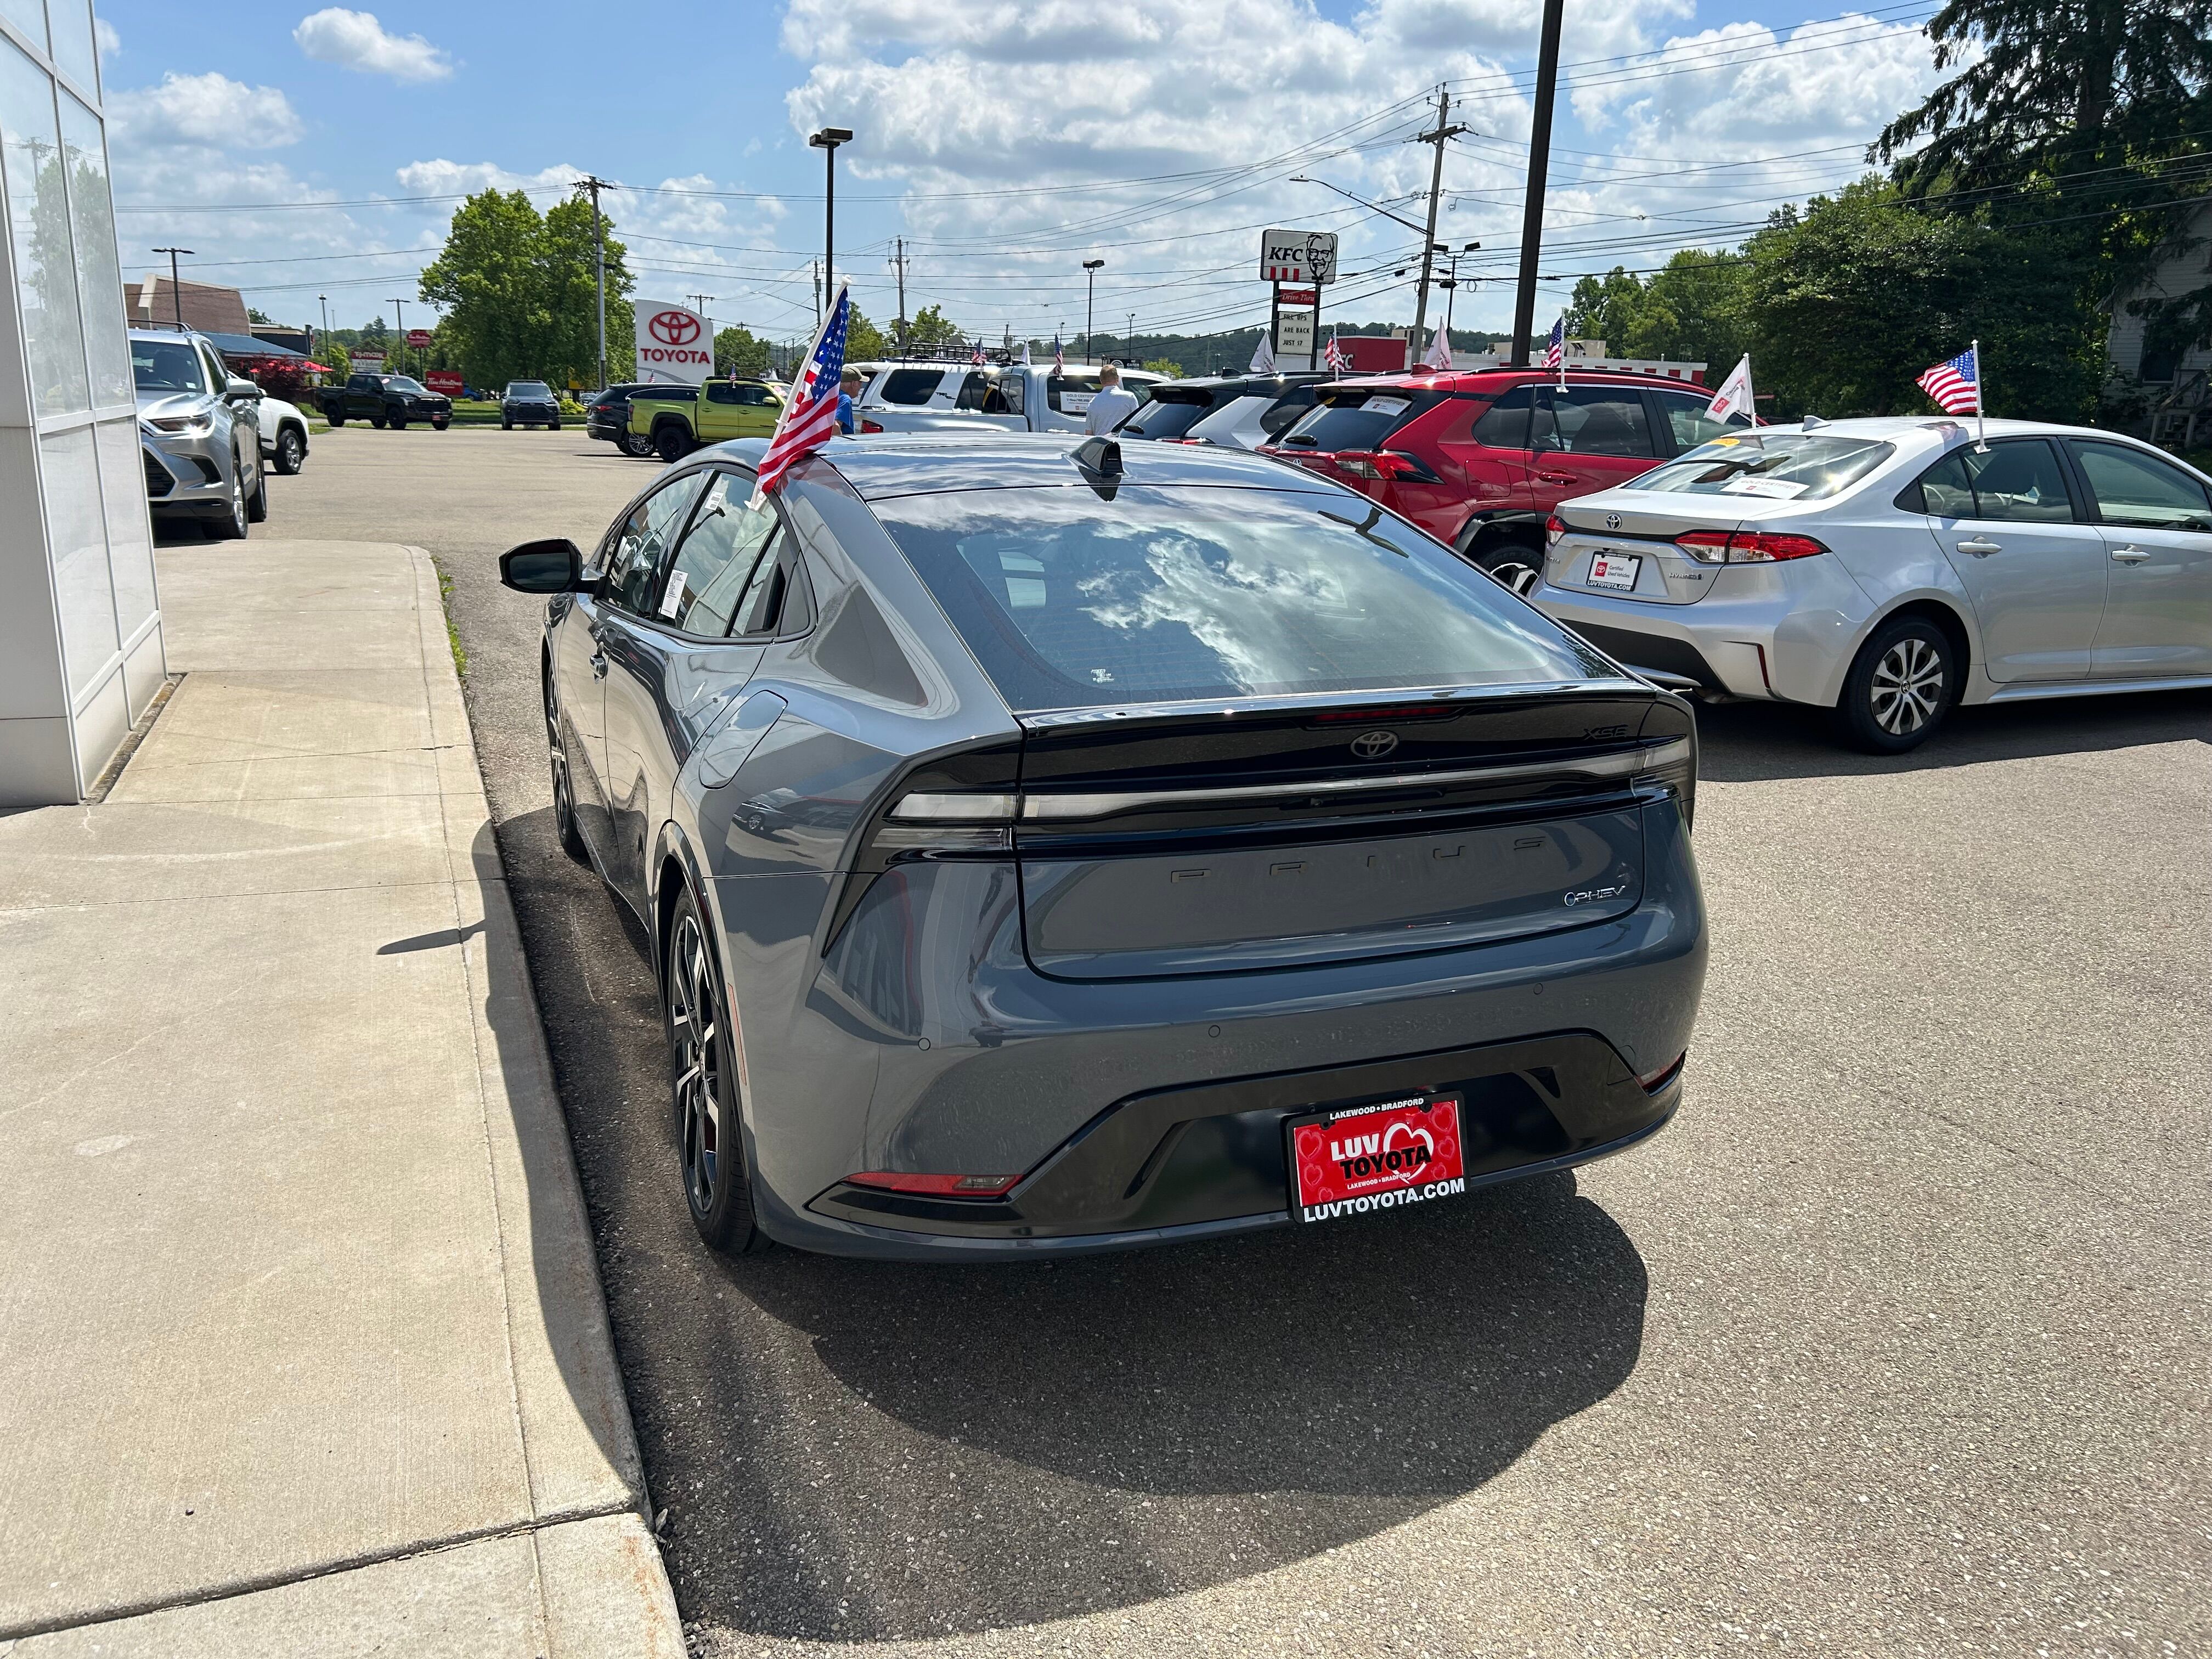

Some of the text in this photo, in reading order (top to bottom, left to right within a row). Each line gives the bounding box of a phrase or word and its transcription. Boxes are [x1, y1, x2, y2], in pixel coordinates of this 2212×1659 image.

[1268, 246, 1304, 262] KFC
[640, 348, 710, 364] TOYOTA
[439, 378, 463, 386] Hortons
[1761, 482, 1797, 490] CERTIFIED
[1587, 580, 1632, 591] LUVTOYOTA.COM
[1583, 724, 1629, 741] XSE
[1170, 836, 1547, 884] PRIUS
[1329, 1098, 1424, 1120] LAKEWOOD BRADFORD
[1330, 1132, 1380, 1161] LUV
[1339, 1144, 1432, 1180] TOYOTA
[1347, 1172, 1411, 1190] LAKEWOOD BRADFORD
[1304, 1178, 1465, 1223] LUVTOYOTA.COM
